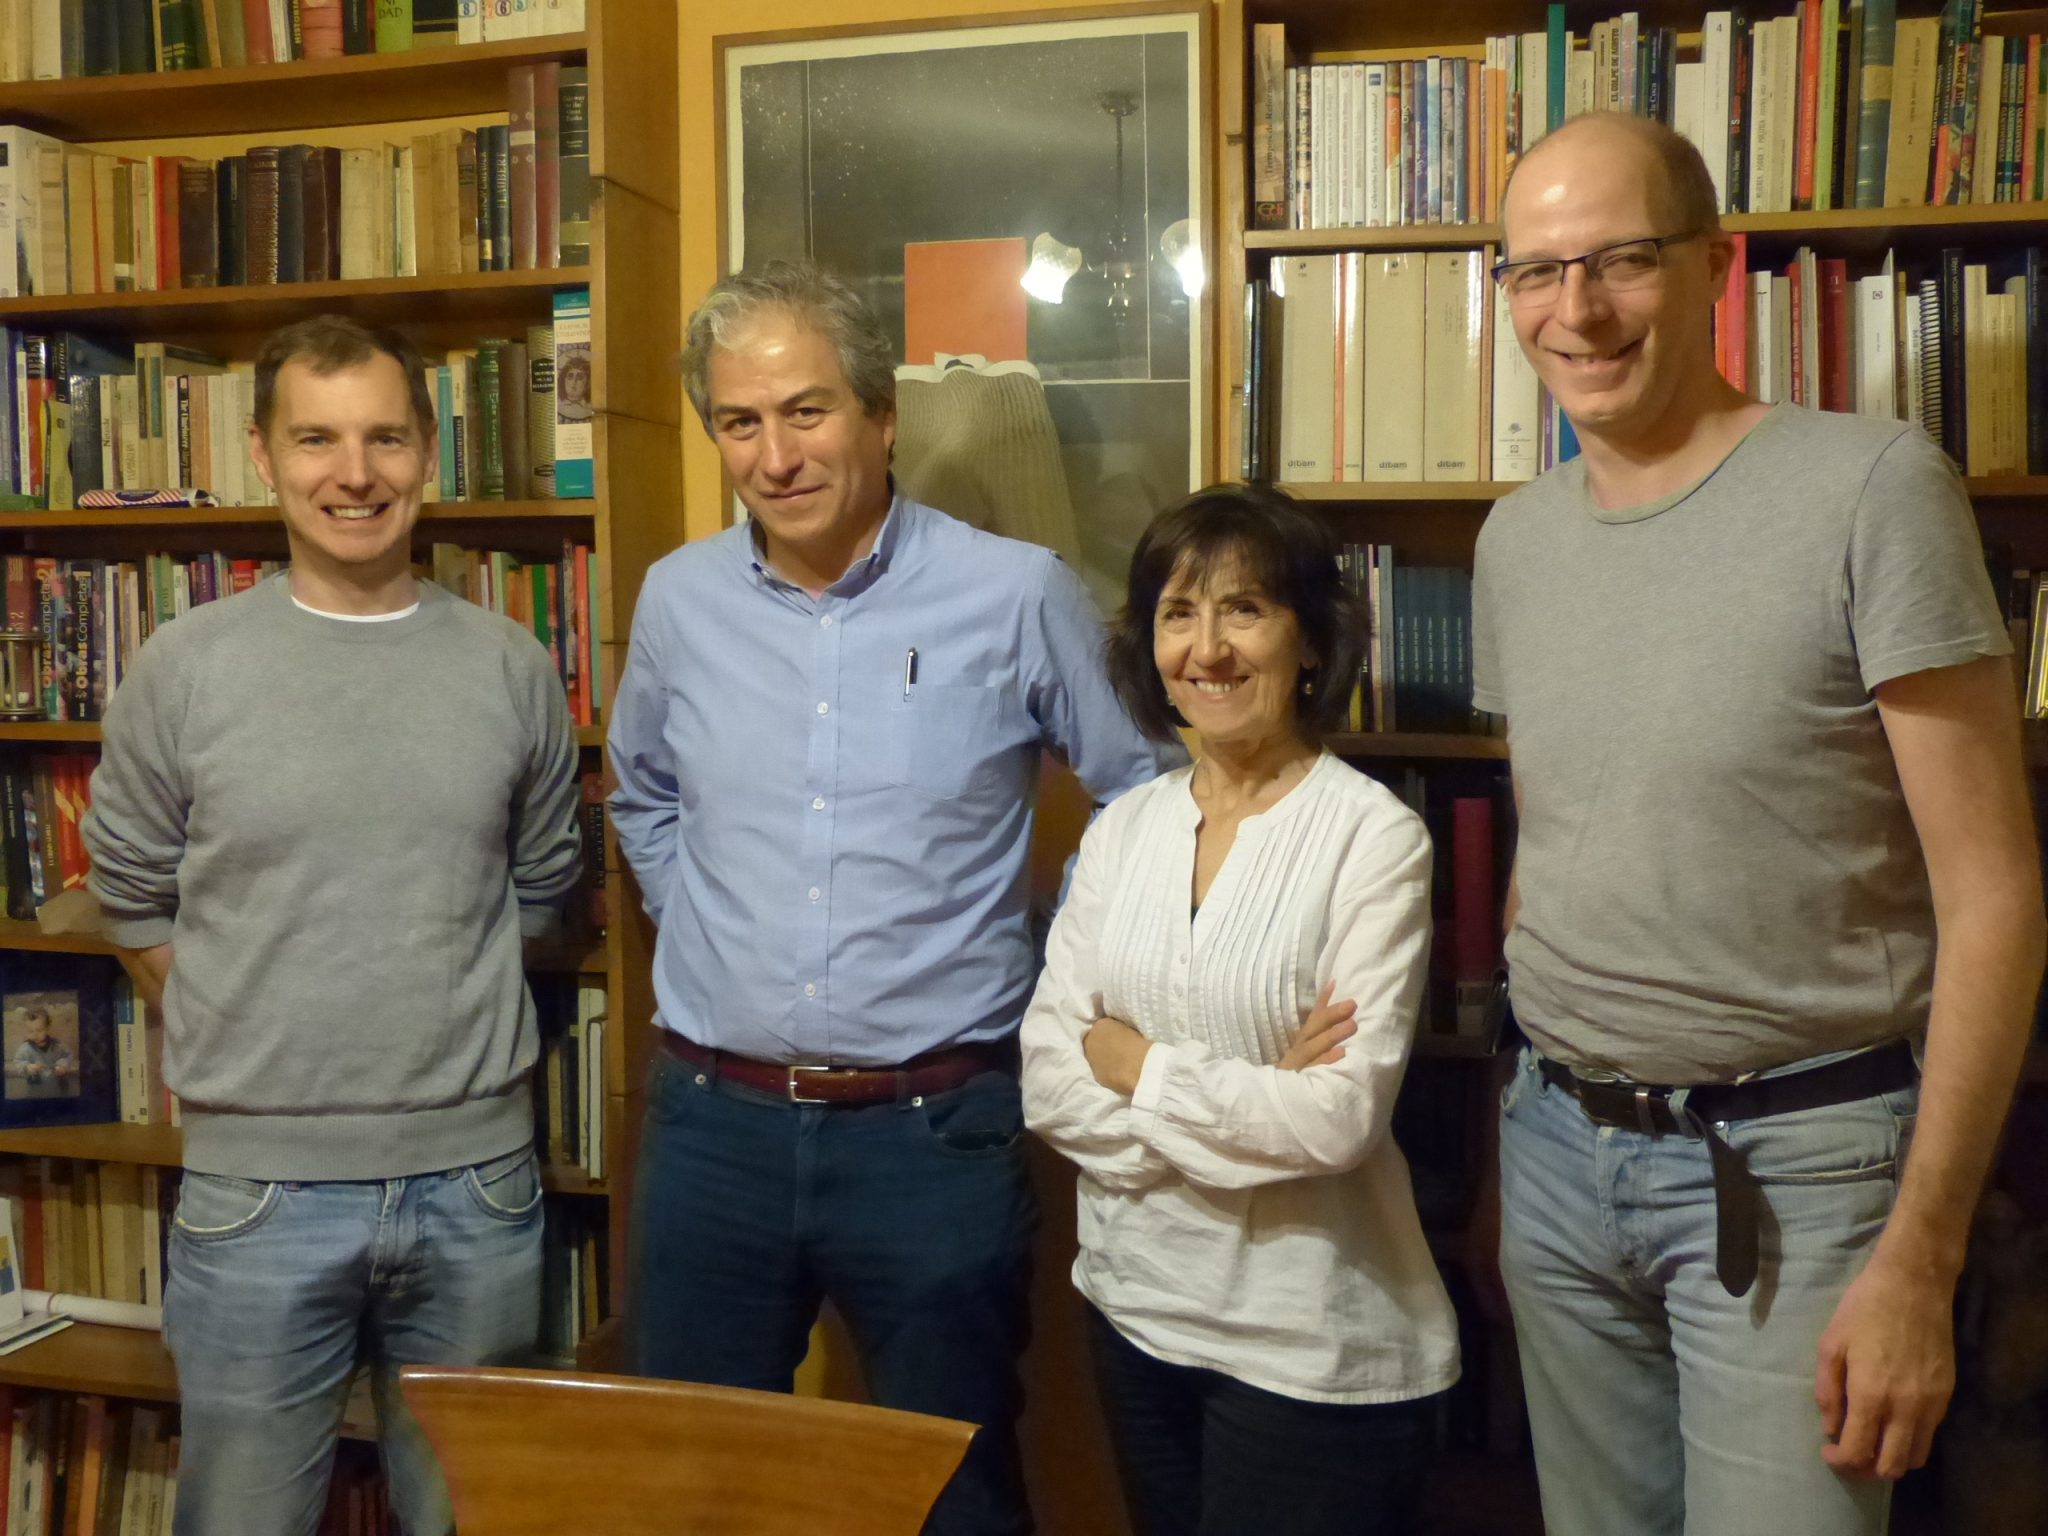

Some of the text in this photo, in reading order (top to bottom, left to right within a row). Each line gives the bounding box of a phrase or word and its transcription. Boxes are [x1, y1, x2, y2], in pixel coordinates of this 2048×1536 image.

[463, 3, 470, 16] 8
[500, 0, 506, 15] 6
[1716, 24, 1722, 32] 4
[1957, 56, 1966, 84] World
[1908, 134, 1913, 145] 2
[496, 152, 507, 208] FLAUBERT
[77, 577, 91, 641] Completas
[37, 568, 56, 688] Obras Completas 2
[76, 642, 87, 689] Obras
